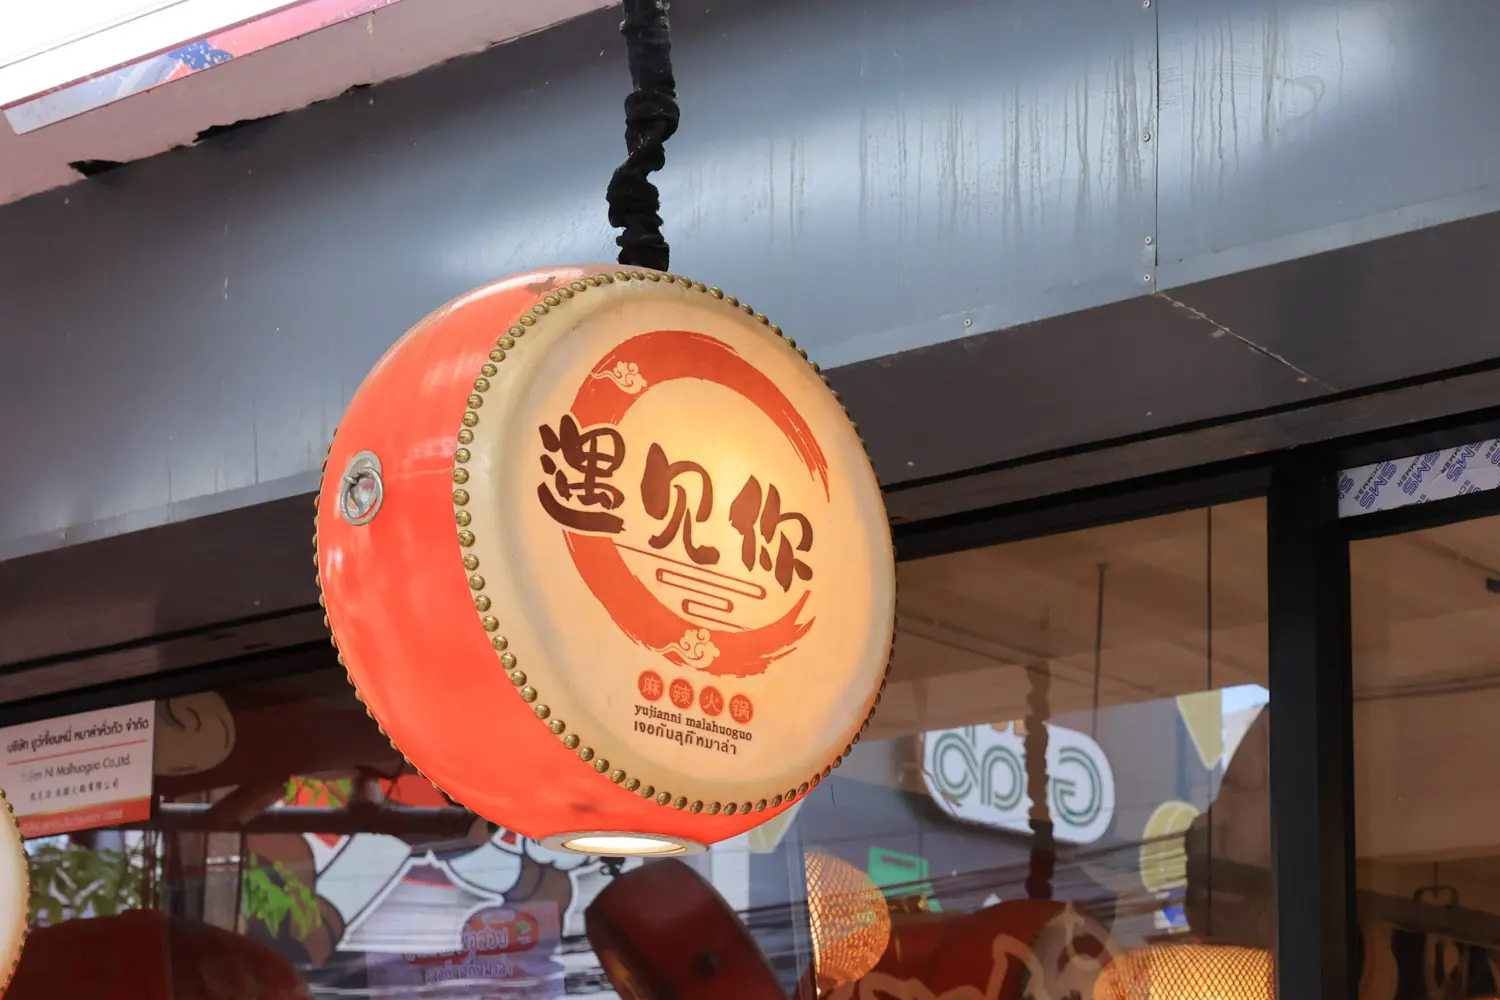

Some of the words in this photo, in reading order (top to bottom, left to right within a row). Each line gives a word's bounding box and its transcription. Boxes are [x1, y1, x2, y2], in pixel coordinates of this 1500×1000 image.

[538, 414, 813, 592] 遇见你
[640, 674, 752, 722] 麻辣火锅
[635, 704, 682, 725] yujianni
[686, 715, 753, 742] malahuoguo
